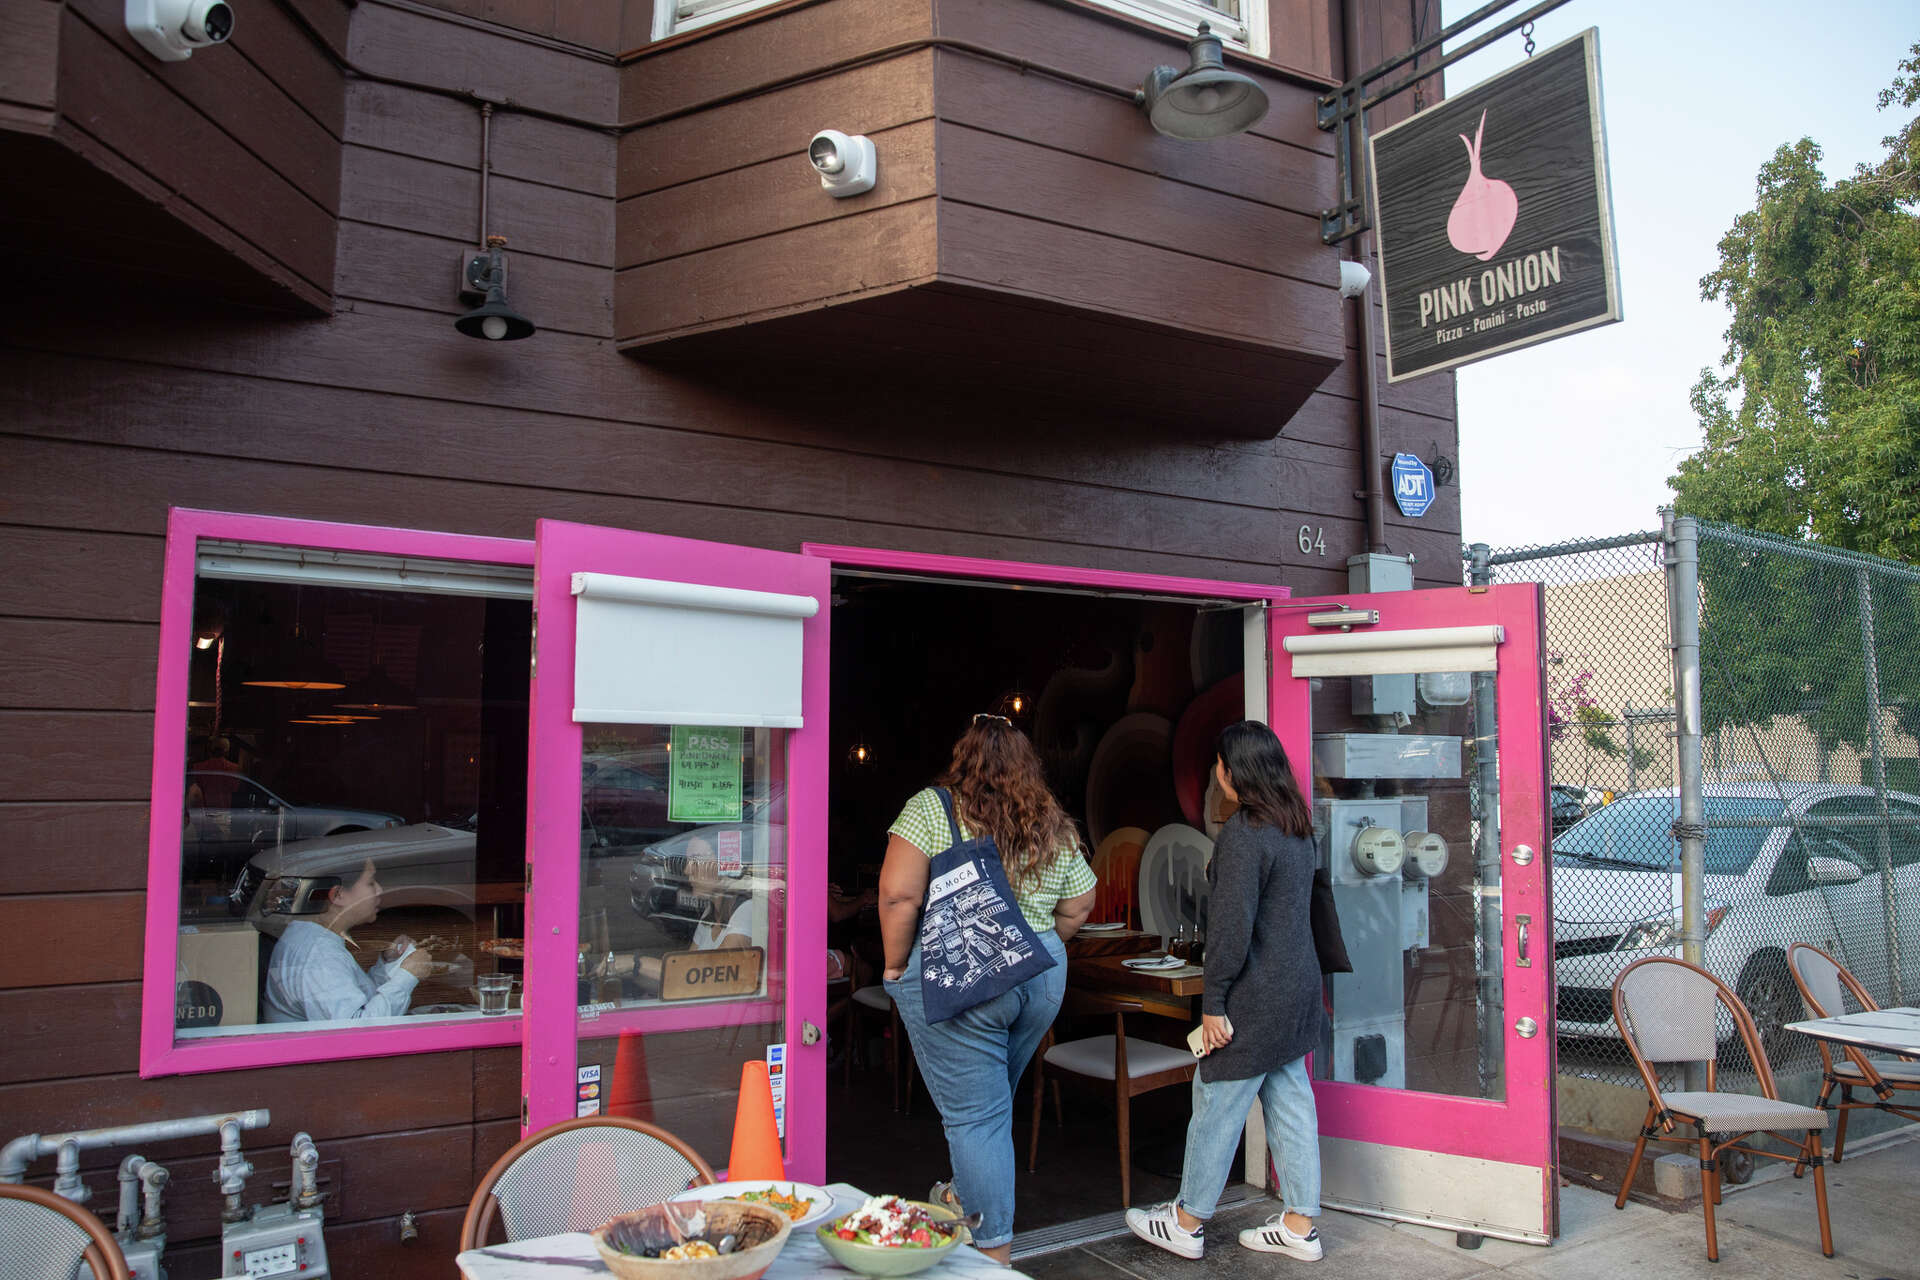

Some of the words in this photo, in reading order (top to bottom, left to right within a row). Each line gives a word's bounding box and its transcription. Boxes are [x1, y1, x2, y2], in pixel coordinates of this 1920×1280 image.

[1419, 277, 1474, 328] PINK
[1481, 246, 1562, 306] ONION
[1436, 326, 1464, 344] Pizza
[1473, 310, 1506, 333] Panini
[1516, 300, 1547, 319] Pasta
[1398, 474, 1425, 496] ADT
[1298, 525, 1326, 556] 64
[688, 736, 729, 750] PASS
[945, 870, 974, 888] MoCA
[686, 965, 740, 985] OPEN
[581, 1069, 599, 1080] VISA
